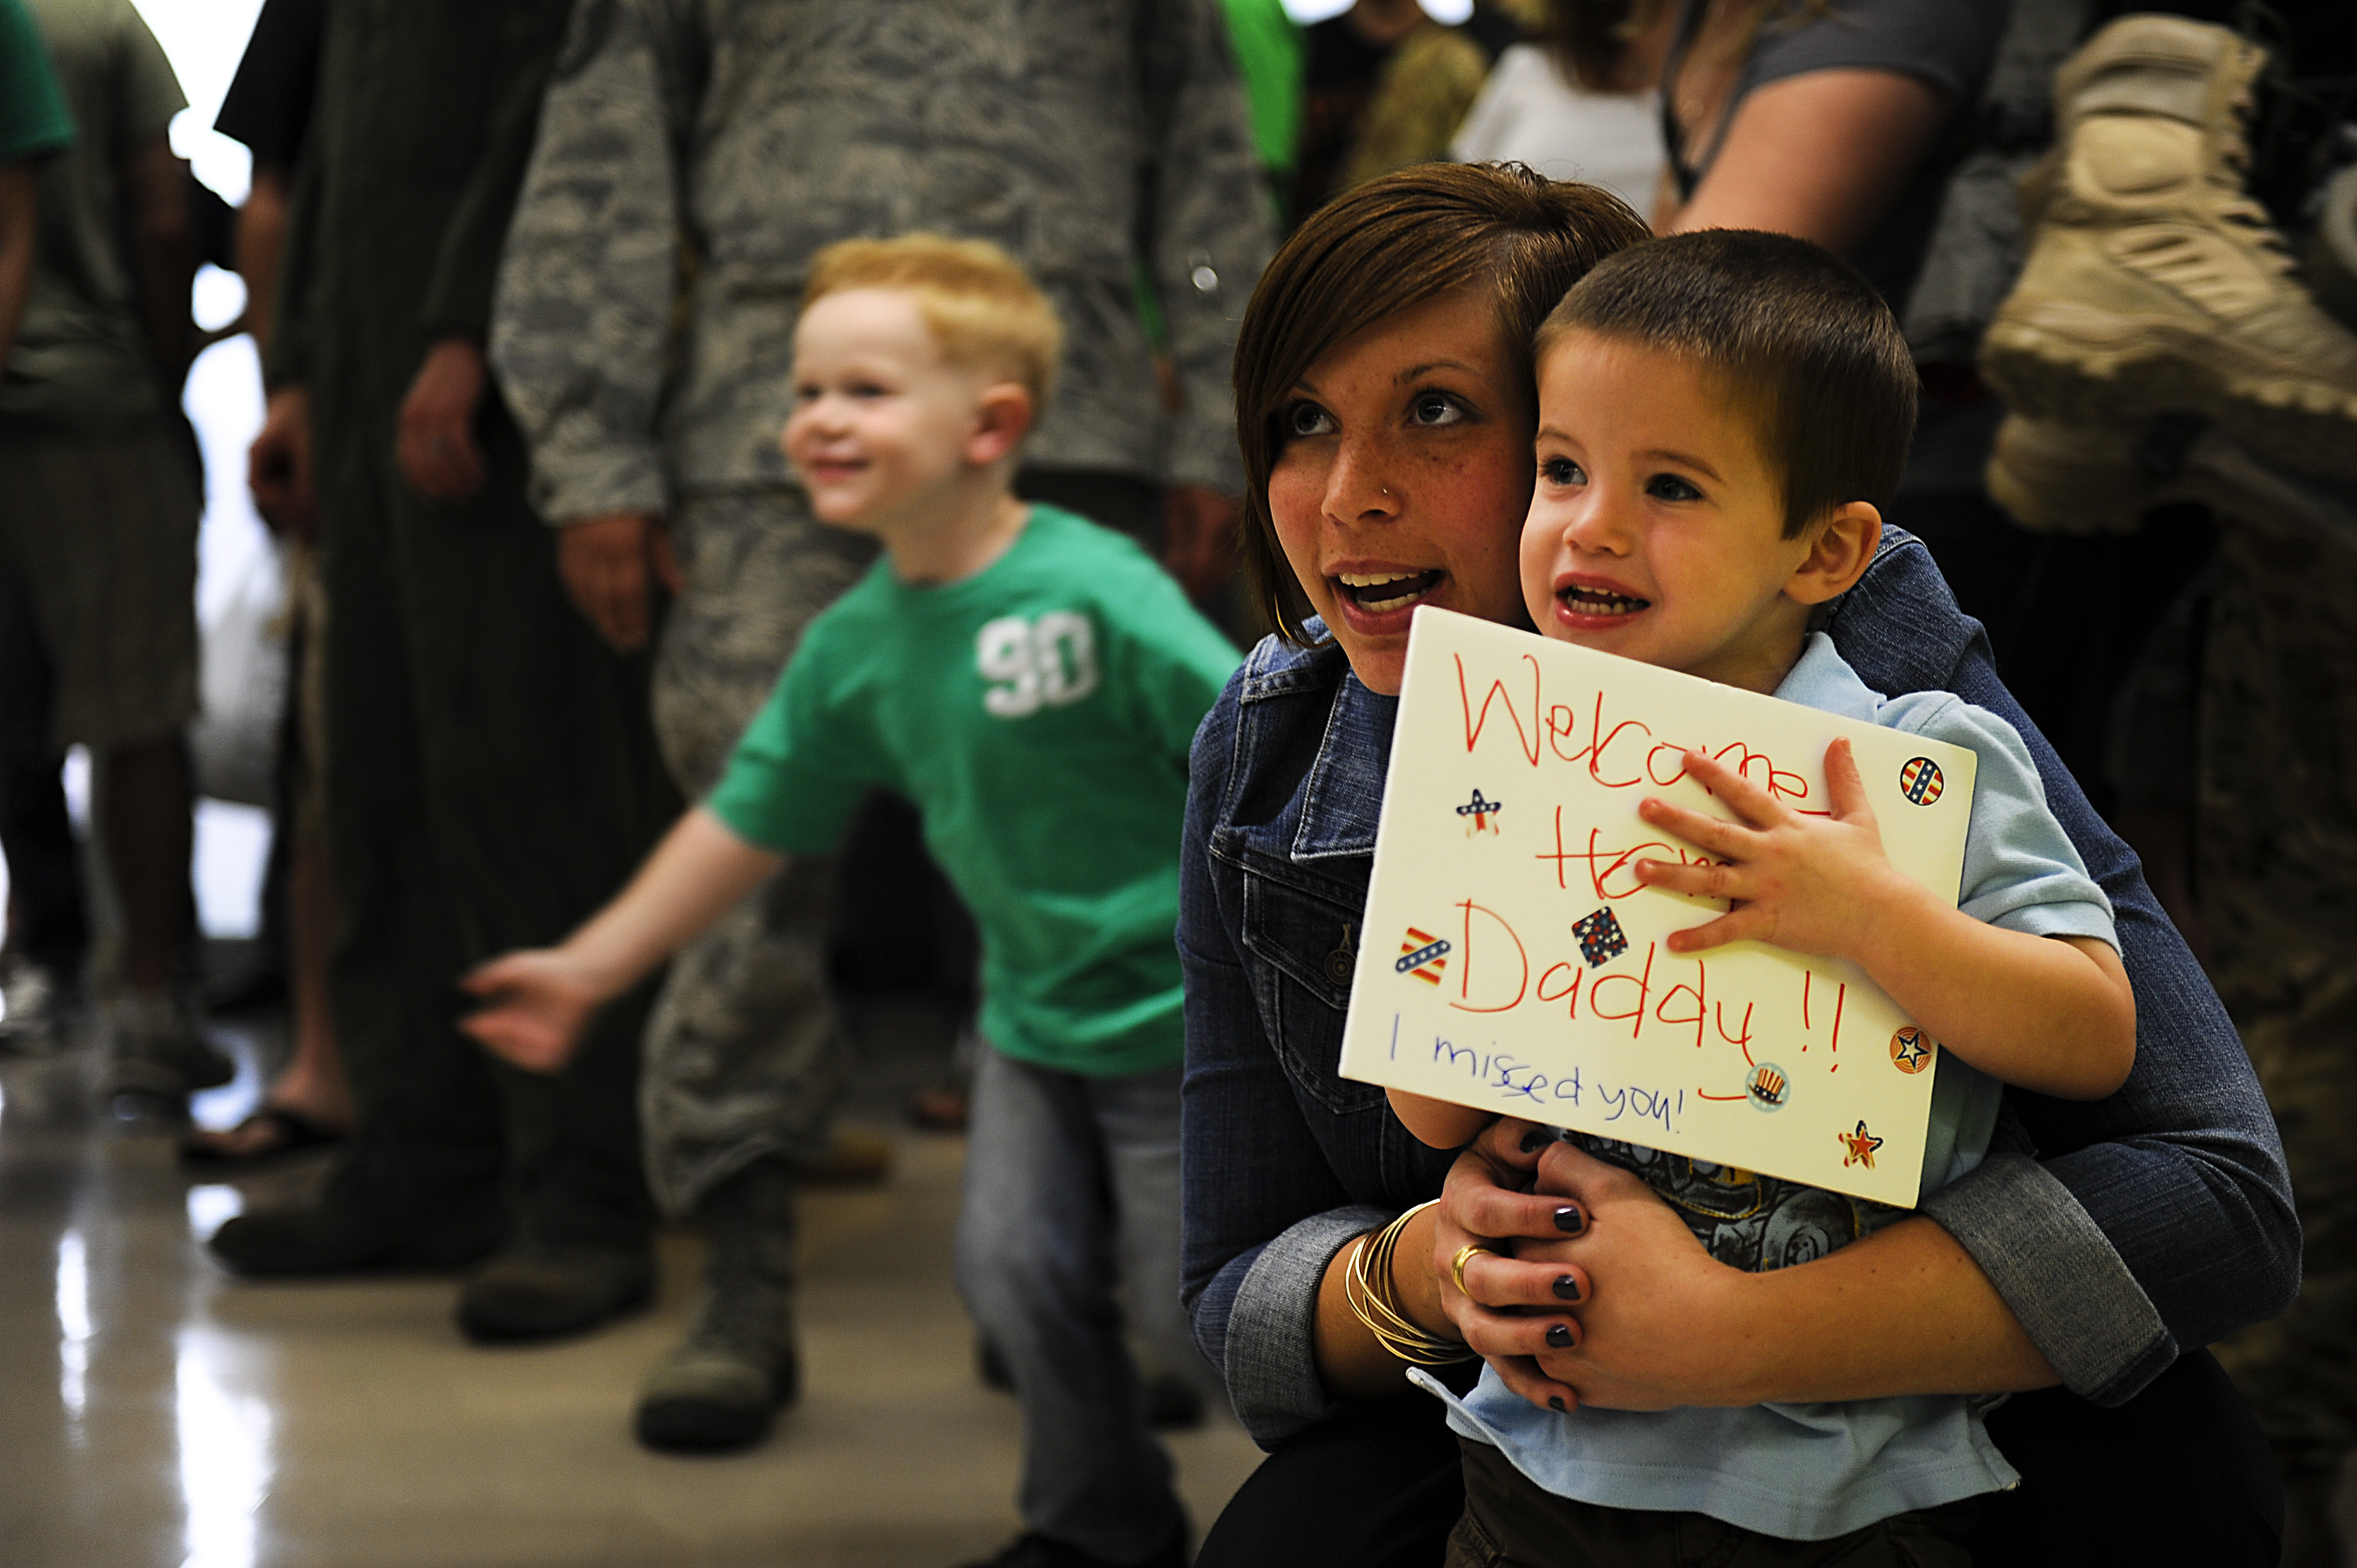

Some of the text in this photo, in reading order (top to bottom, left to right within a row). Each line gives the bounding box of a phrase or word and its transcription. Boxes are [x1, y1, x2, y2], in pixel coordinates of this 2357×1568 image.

[977, 612, 1098, 717] 90
[1390, 1014, 1400, 1061] I
[1597, 1082, 1685, 1135] you!
